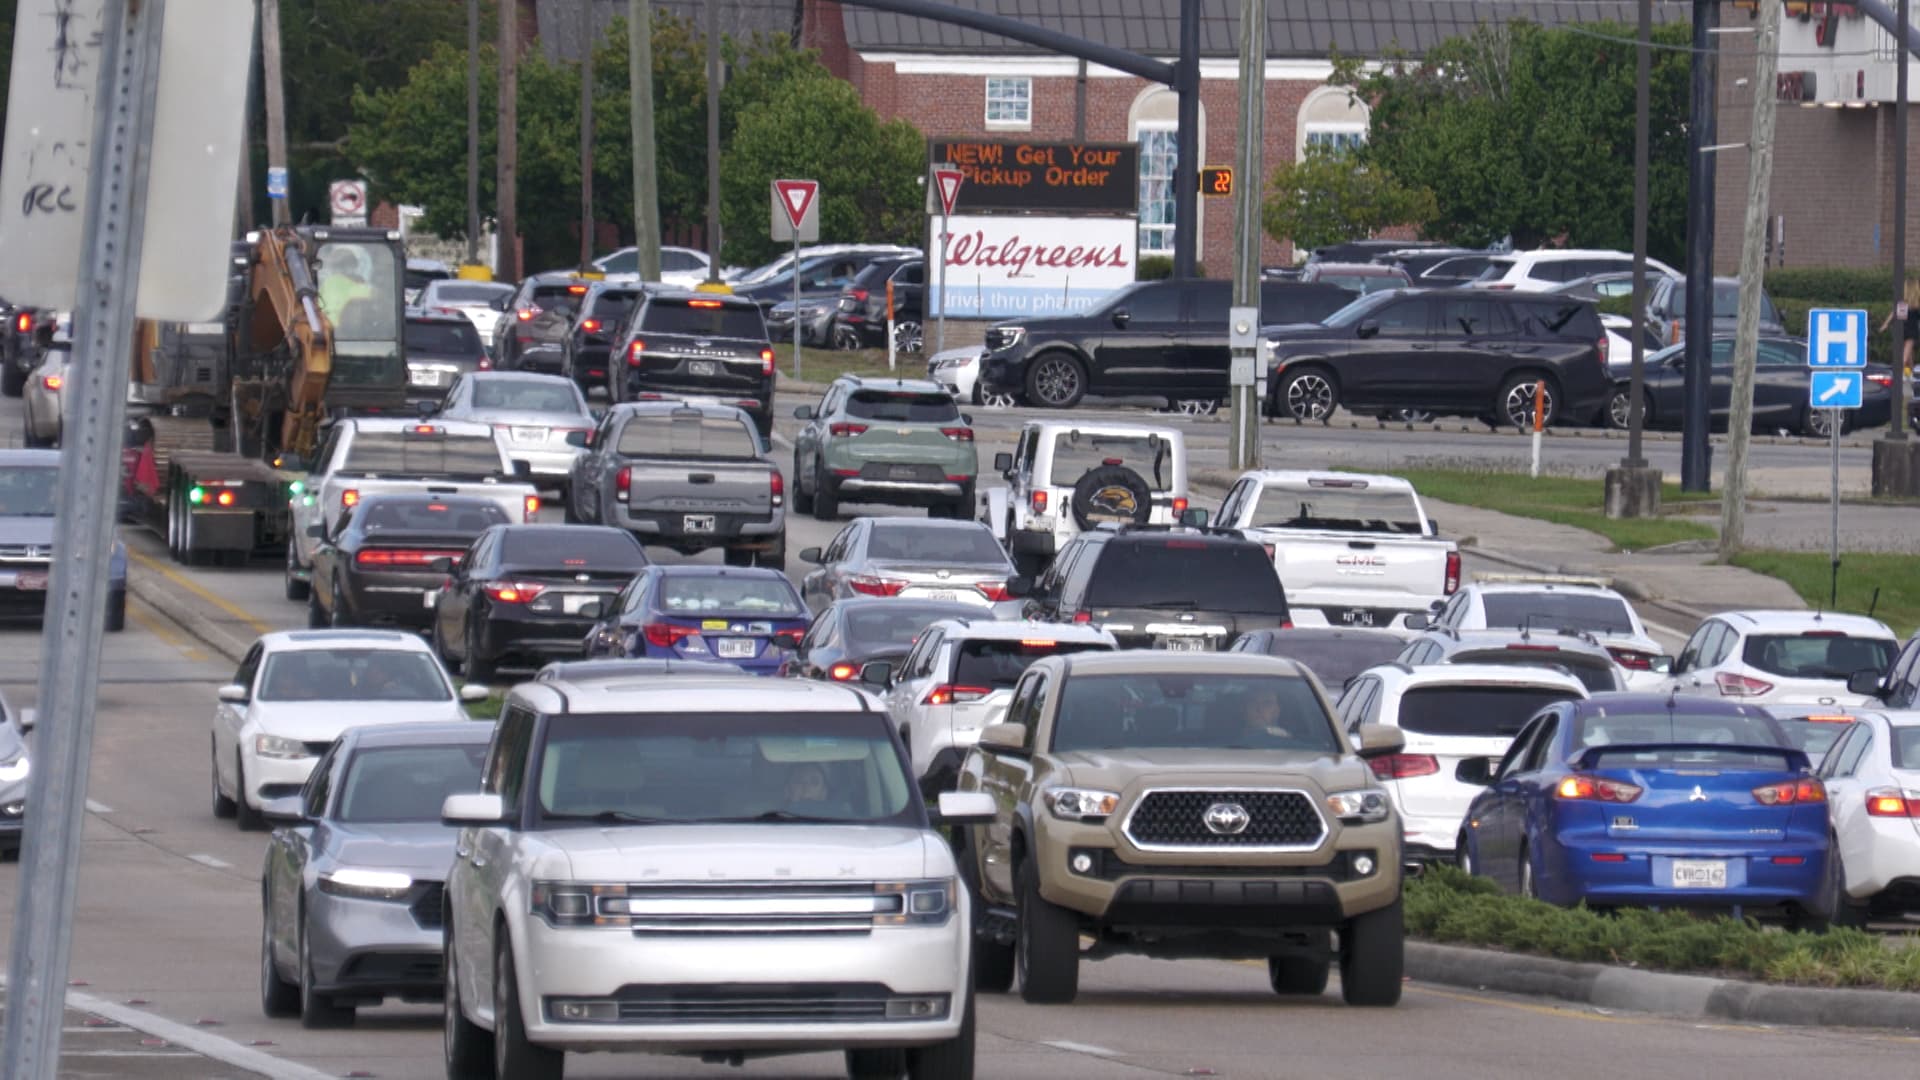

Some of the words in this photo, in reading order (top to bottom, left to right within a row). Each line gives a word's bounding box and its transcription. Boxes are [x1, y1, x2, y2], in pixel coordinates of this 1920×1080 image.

[946, 144, 1003, 164] NEW!
[1016, 145, 1055, 165] Get
[1069, 146, 1120, 165] Your
[960, 166, 1032, 187] Pickup
[1045, 167, 1110, 186] Order
[938, 230, 1129, 277] Walgreens
[990, 293, 1027, 310] thru
[1818, 313, 1858, 363] H
